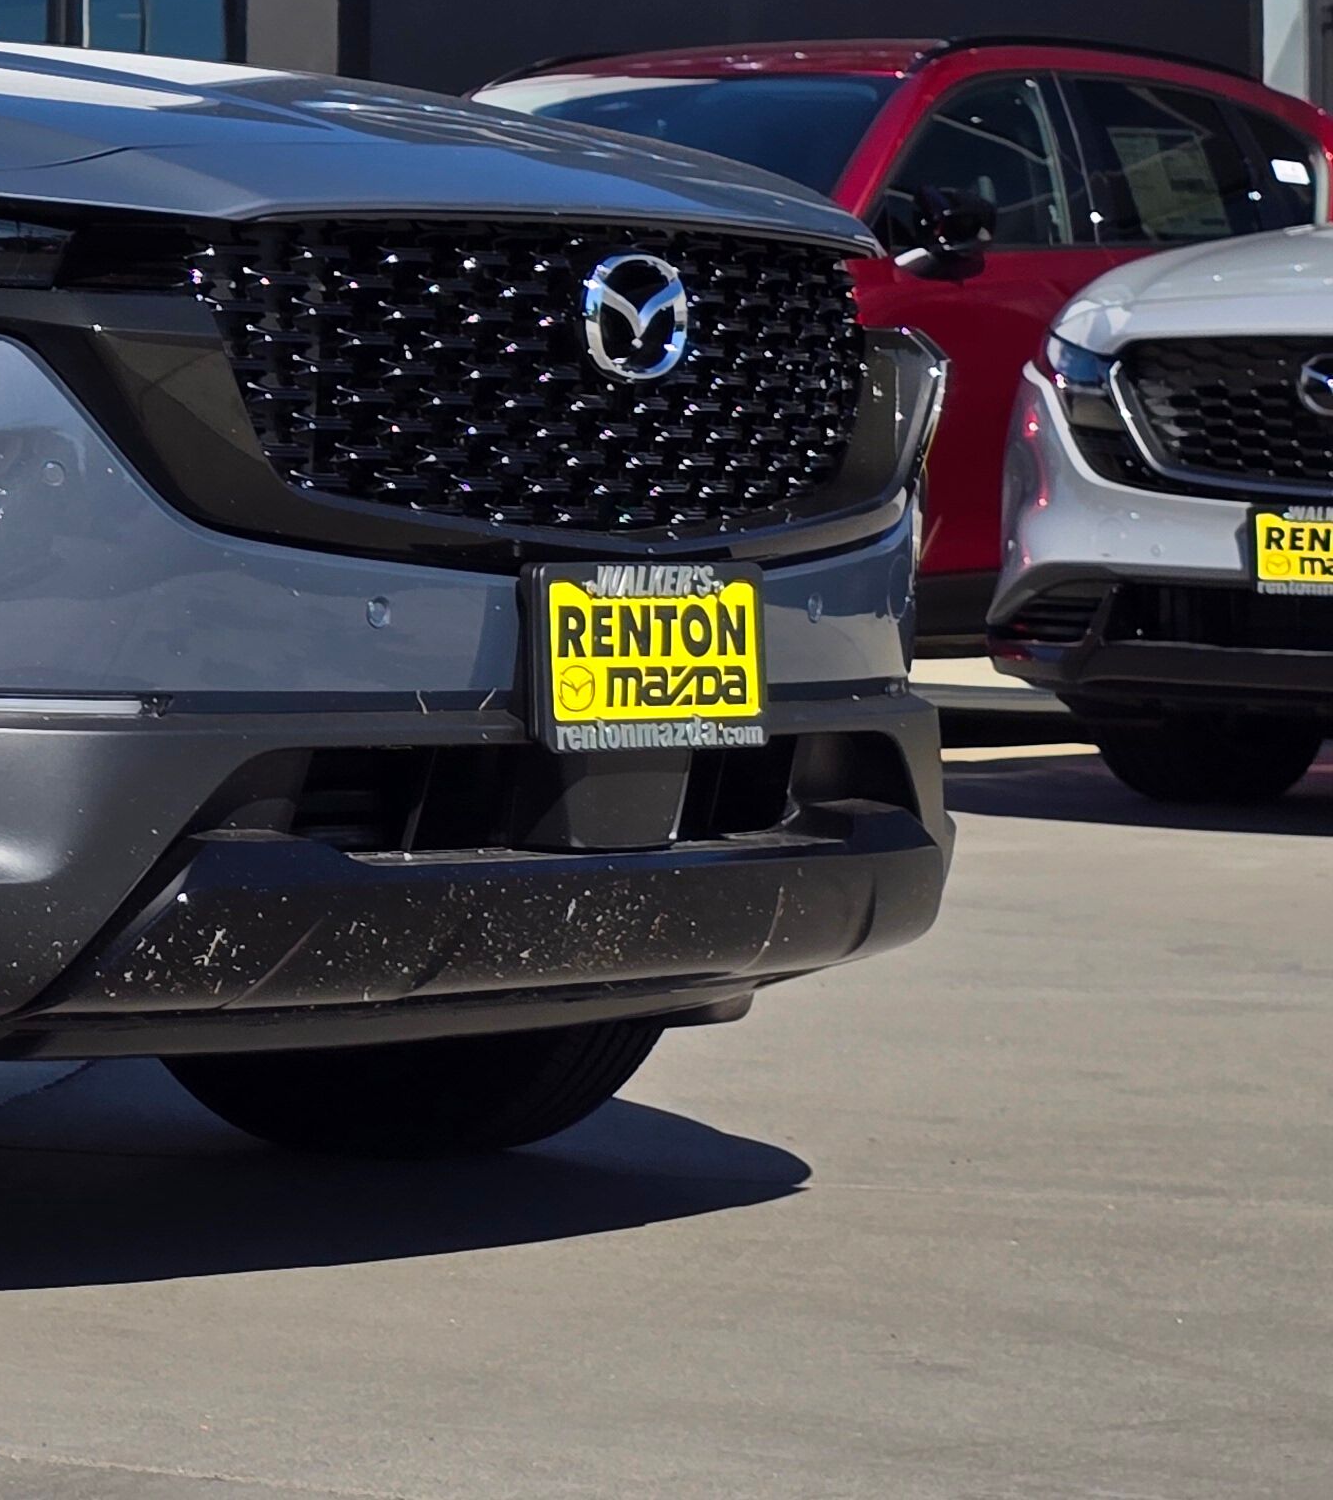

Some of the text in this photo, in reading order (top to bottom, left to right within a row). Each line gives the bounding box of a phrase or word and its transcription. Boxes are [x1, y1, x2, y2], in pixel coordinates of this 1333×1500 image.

[596, 565, 714, 597] WALKER'S
[556, 603, 747, 659] RENTON
[556, 715, 764, 751] rentonmazda.com
